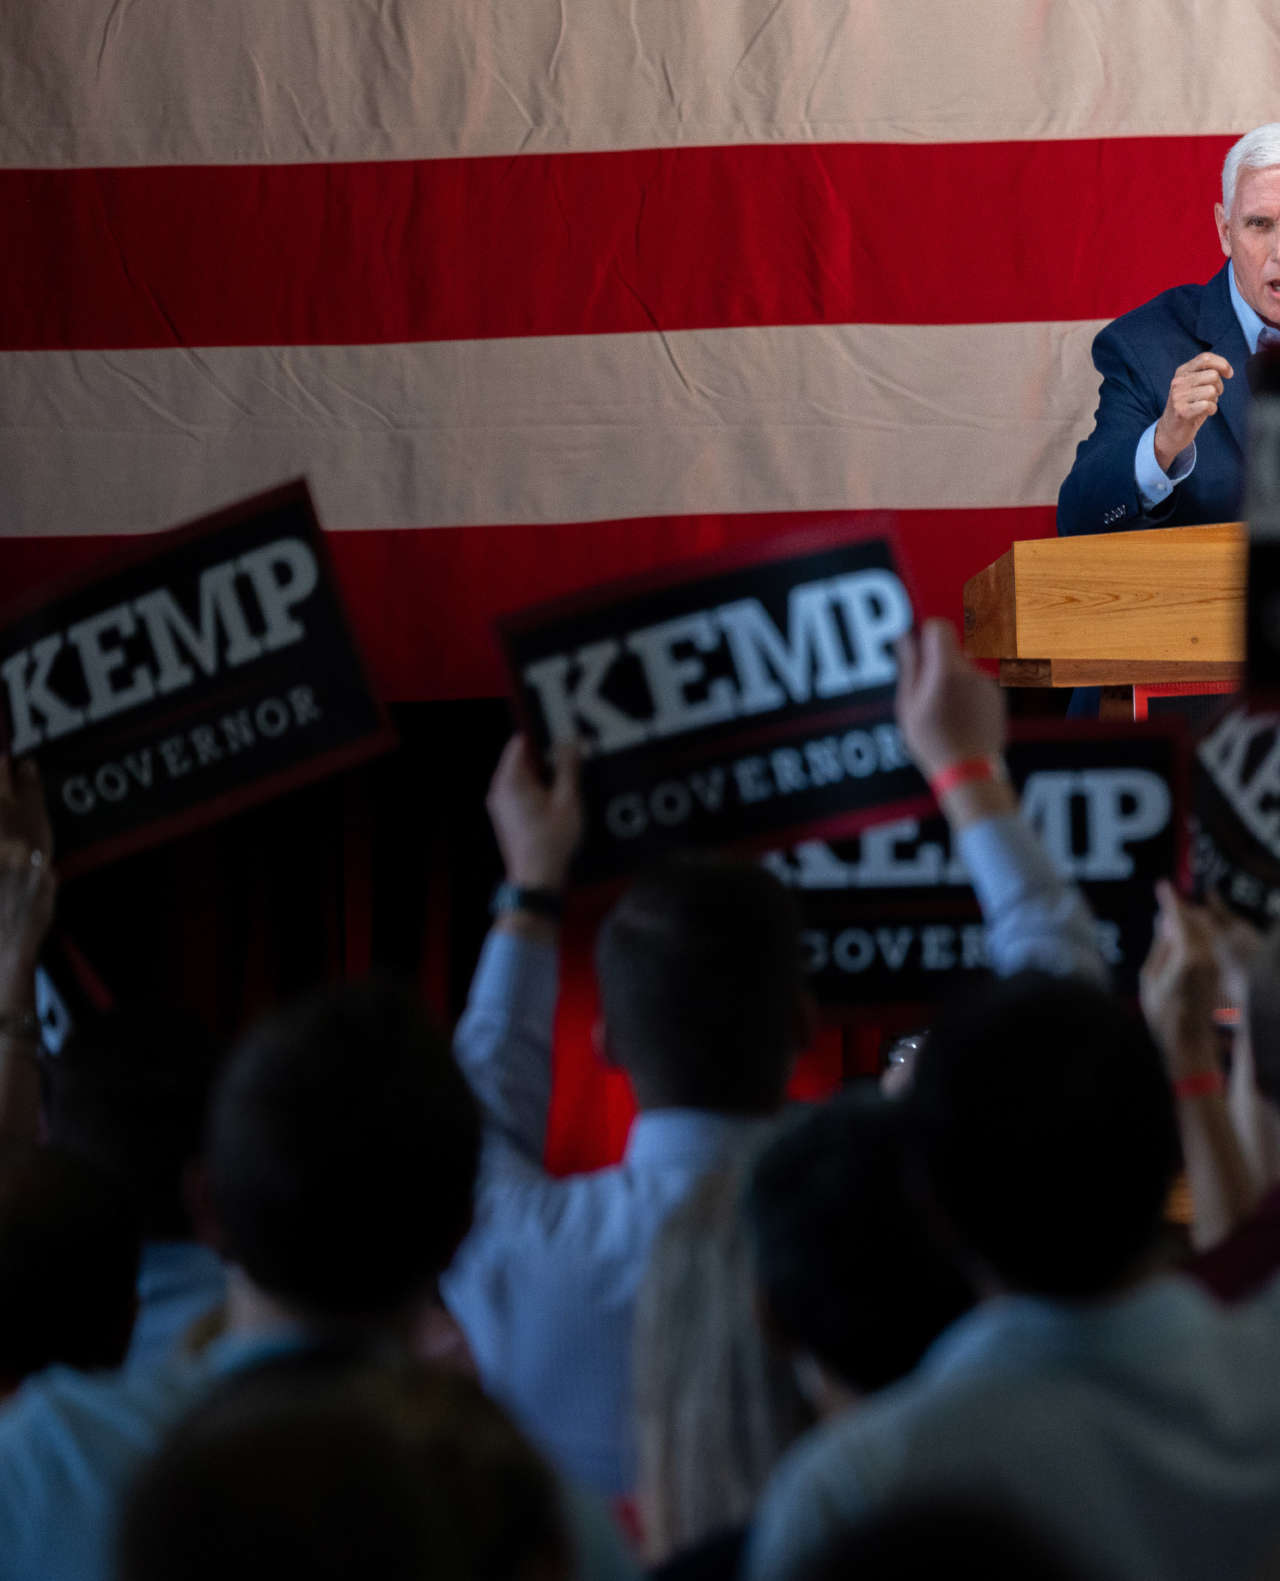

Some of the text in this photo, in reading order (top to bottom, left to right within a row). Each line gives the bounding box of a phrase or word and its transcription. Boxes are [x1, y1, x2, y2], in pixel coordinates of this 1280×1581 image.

[0, 535, 320, 757] KEMP
[523, 567, 914, 764] KEMP
[61, 684, 323, 815] GOVERNOR
